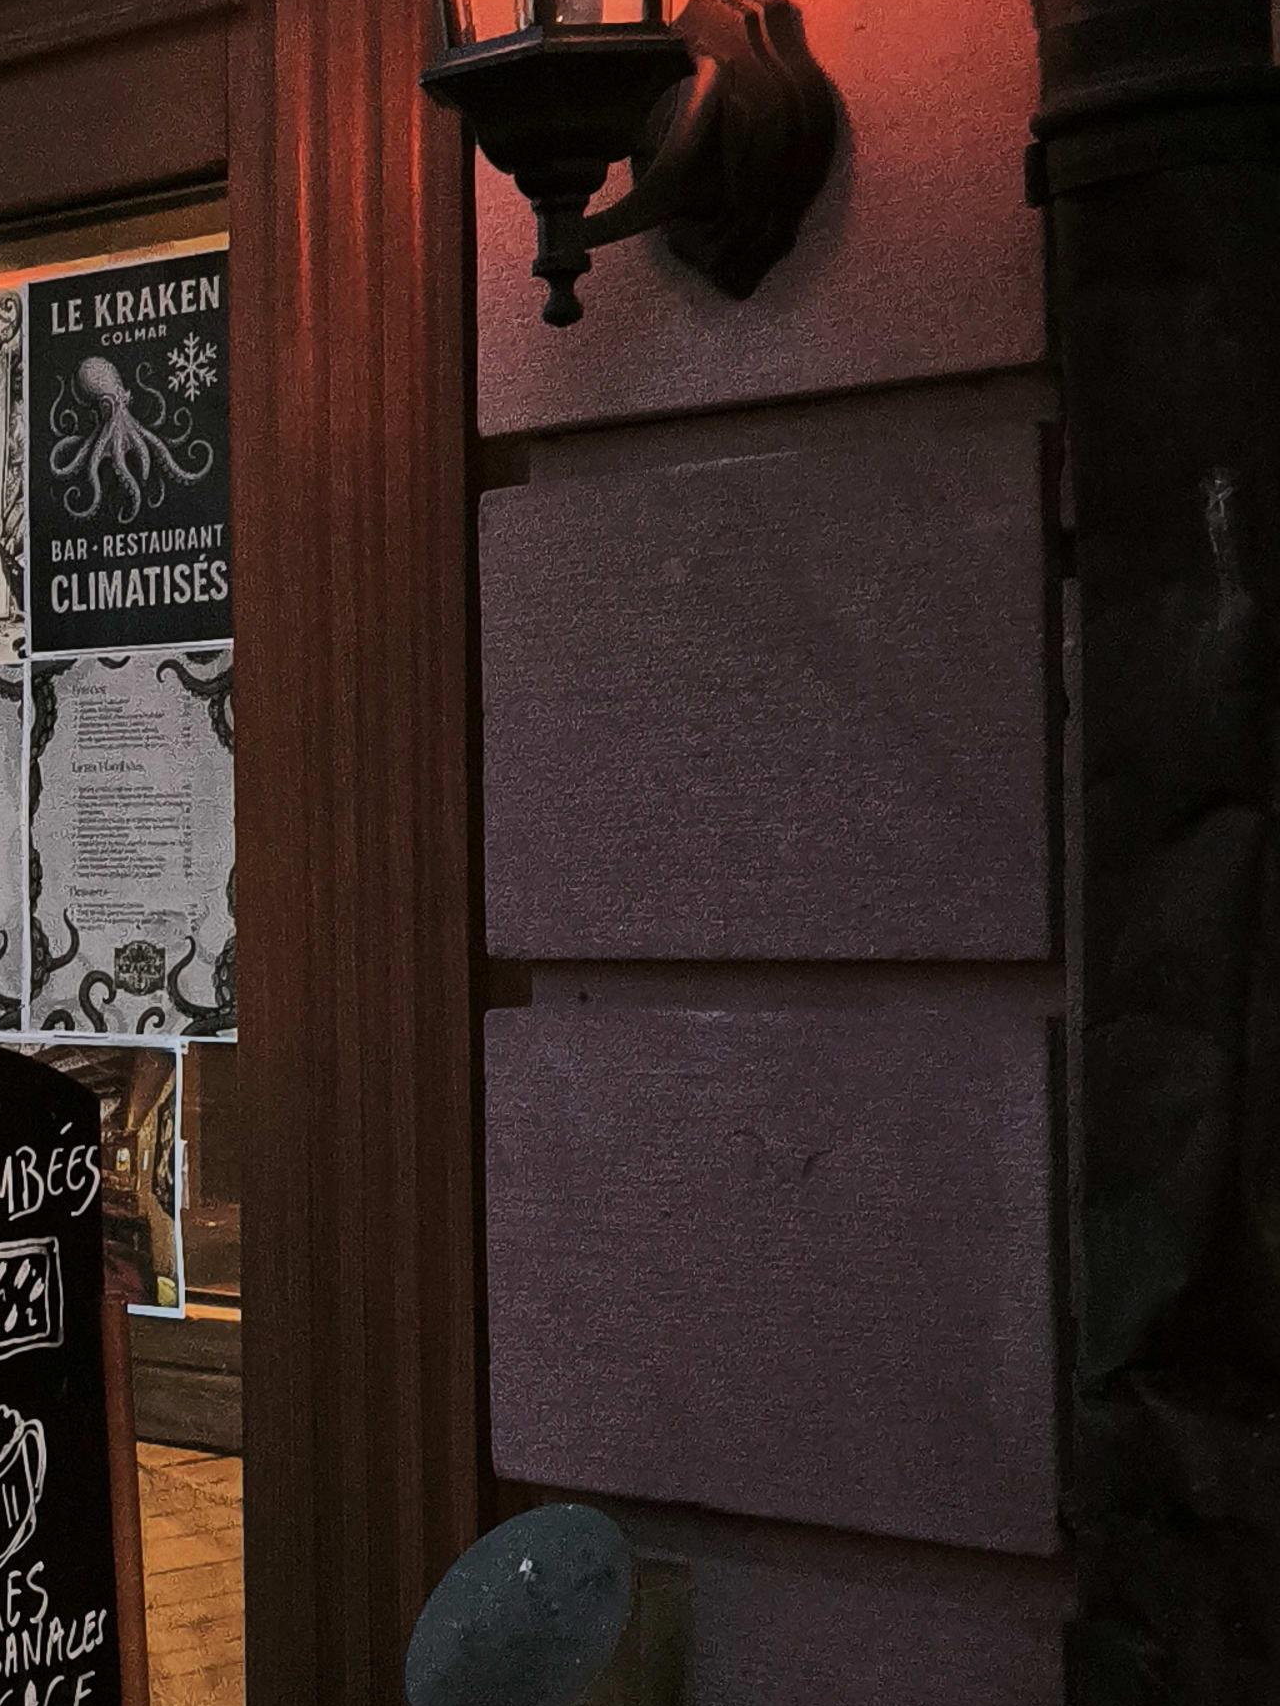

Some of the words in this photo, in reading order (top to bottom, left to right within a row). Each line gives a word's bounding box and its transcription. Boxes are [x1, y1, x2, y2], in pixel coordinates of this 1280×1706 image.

[50, 298, 84, 336] LE
[93, 274, 221, 329] KRAKEN
[101, 325, 167, 347] COLMAR
[102, 523, 225, 558] RESTAURANT
[50, 553, 229, 614] CLIMATISÉS
